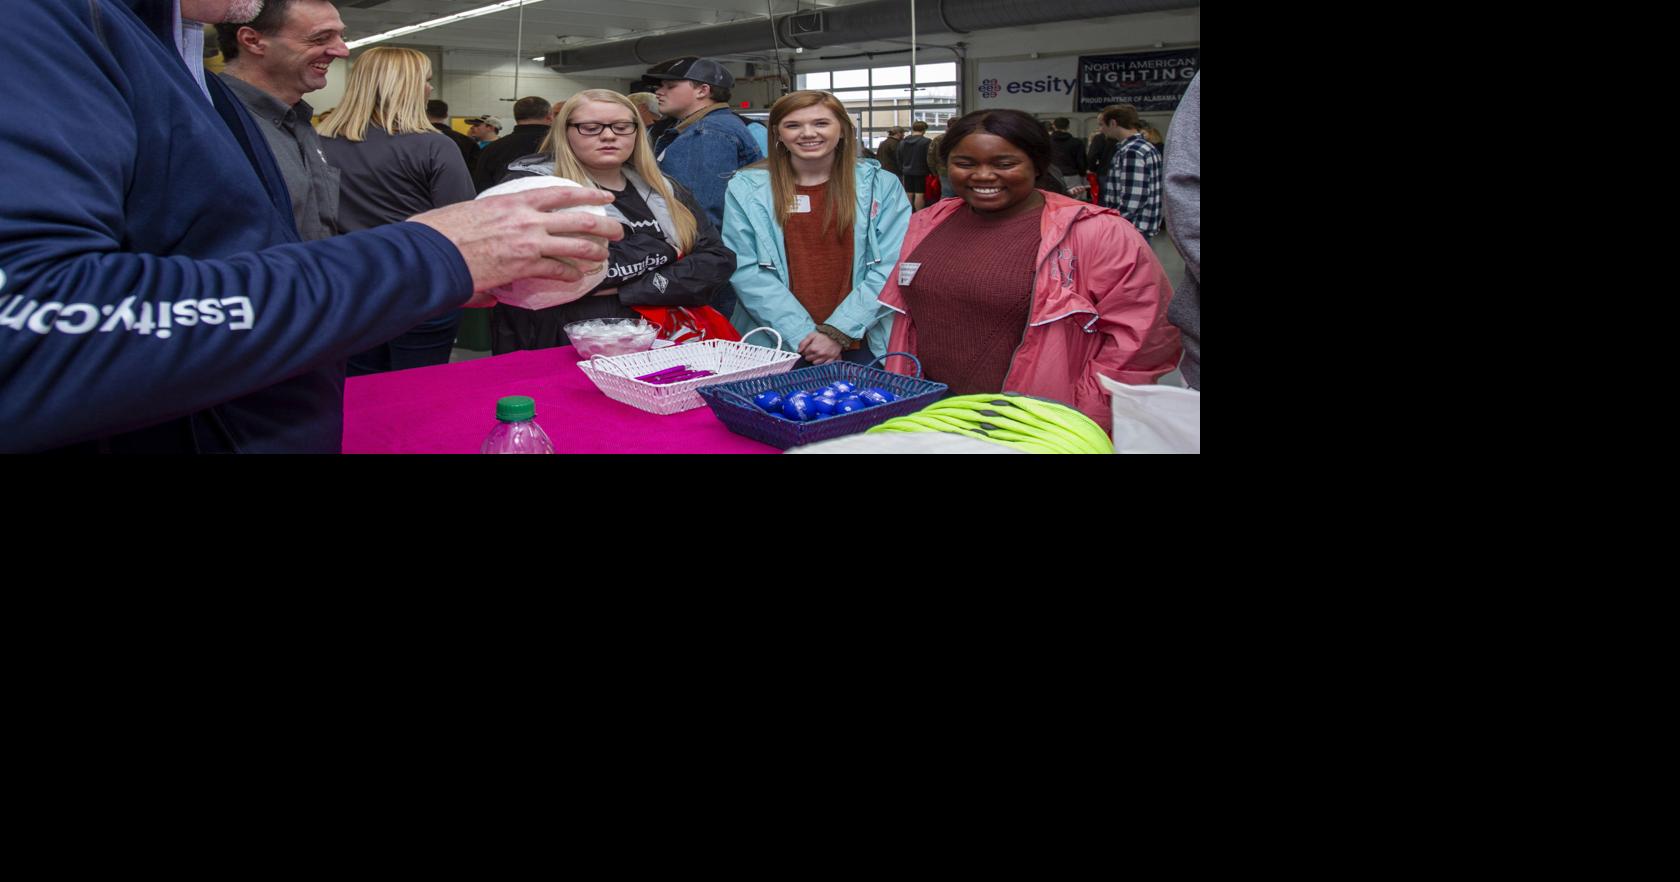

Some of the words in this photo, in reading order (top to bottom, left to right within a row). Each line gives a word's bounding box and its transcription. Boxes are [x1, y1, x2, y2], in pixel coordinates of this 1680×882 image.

[1084, 61, 1126, 72] NORTH
[1128, 57, 1195, 70] AMERICAN
[1084, 67, 1195, 84] LIGHTING
[1006, 75, 1077, 95] essity
[1143, 94, 1177, 102] ALABAMA
[607, 253, 668, 278] olumbia
